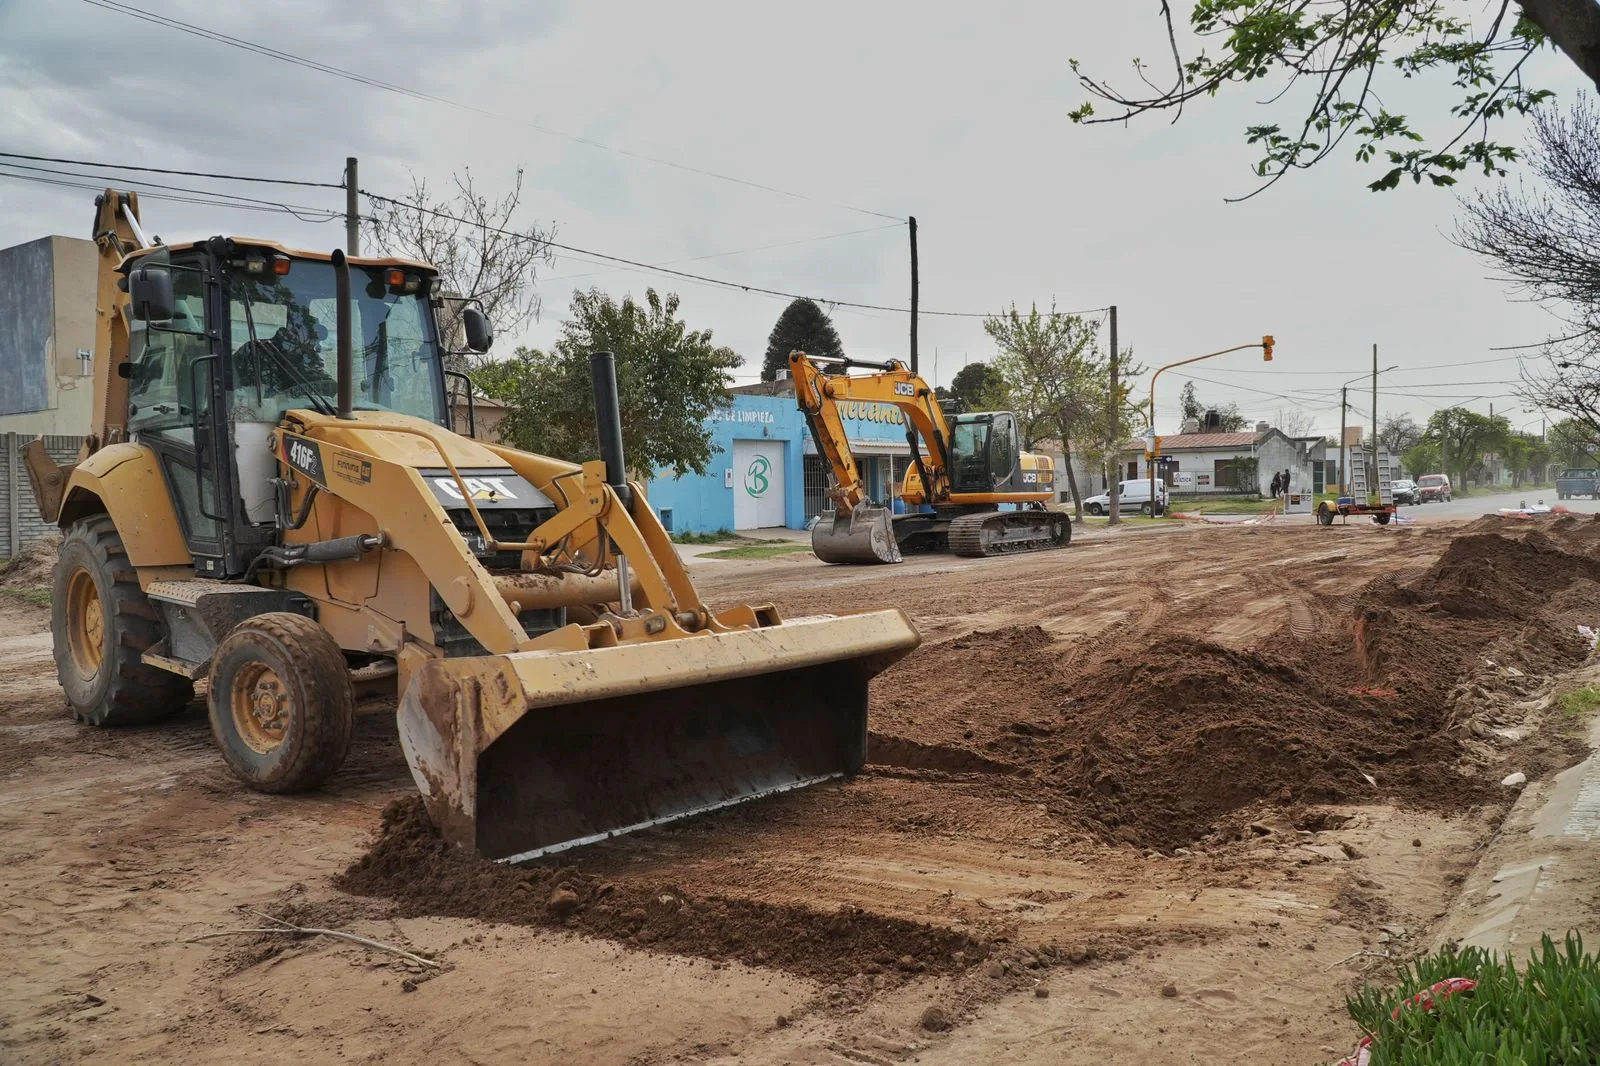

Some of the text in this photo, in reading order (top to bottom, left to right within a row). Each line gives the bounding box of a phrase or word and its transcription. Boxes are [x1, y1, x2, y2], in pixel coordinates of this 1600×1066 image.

[895, 382, 914, 396] JCB
[738, 410, 775, 423] LIMPIEZA
[1022, 472, 1037, 483] JCB
[434, 478, 519, 500] CAT
